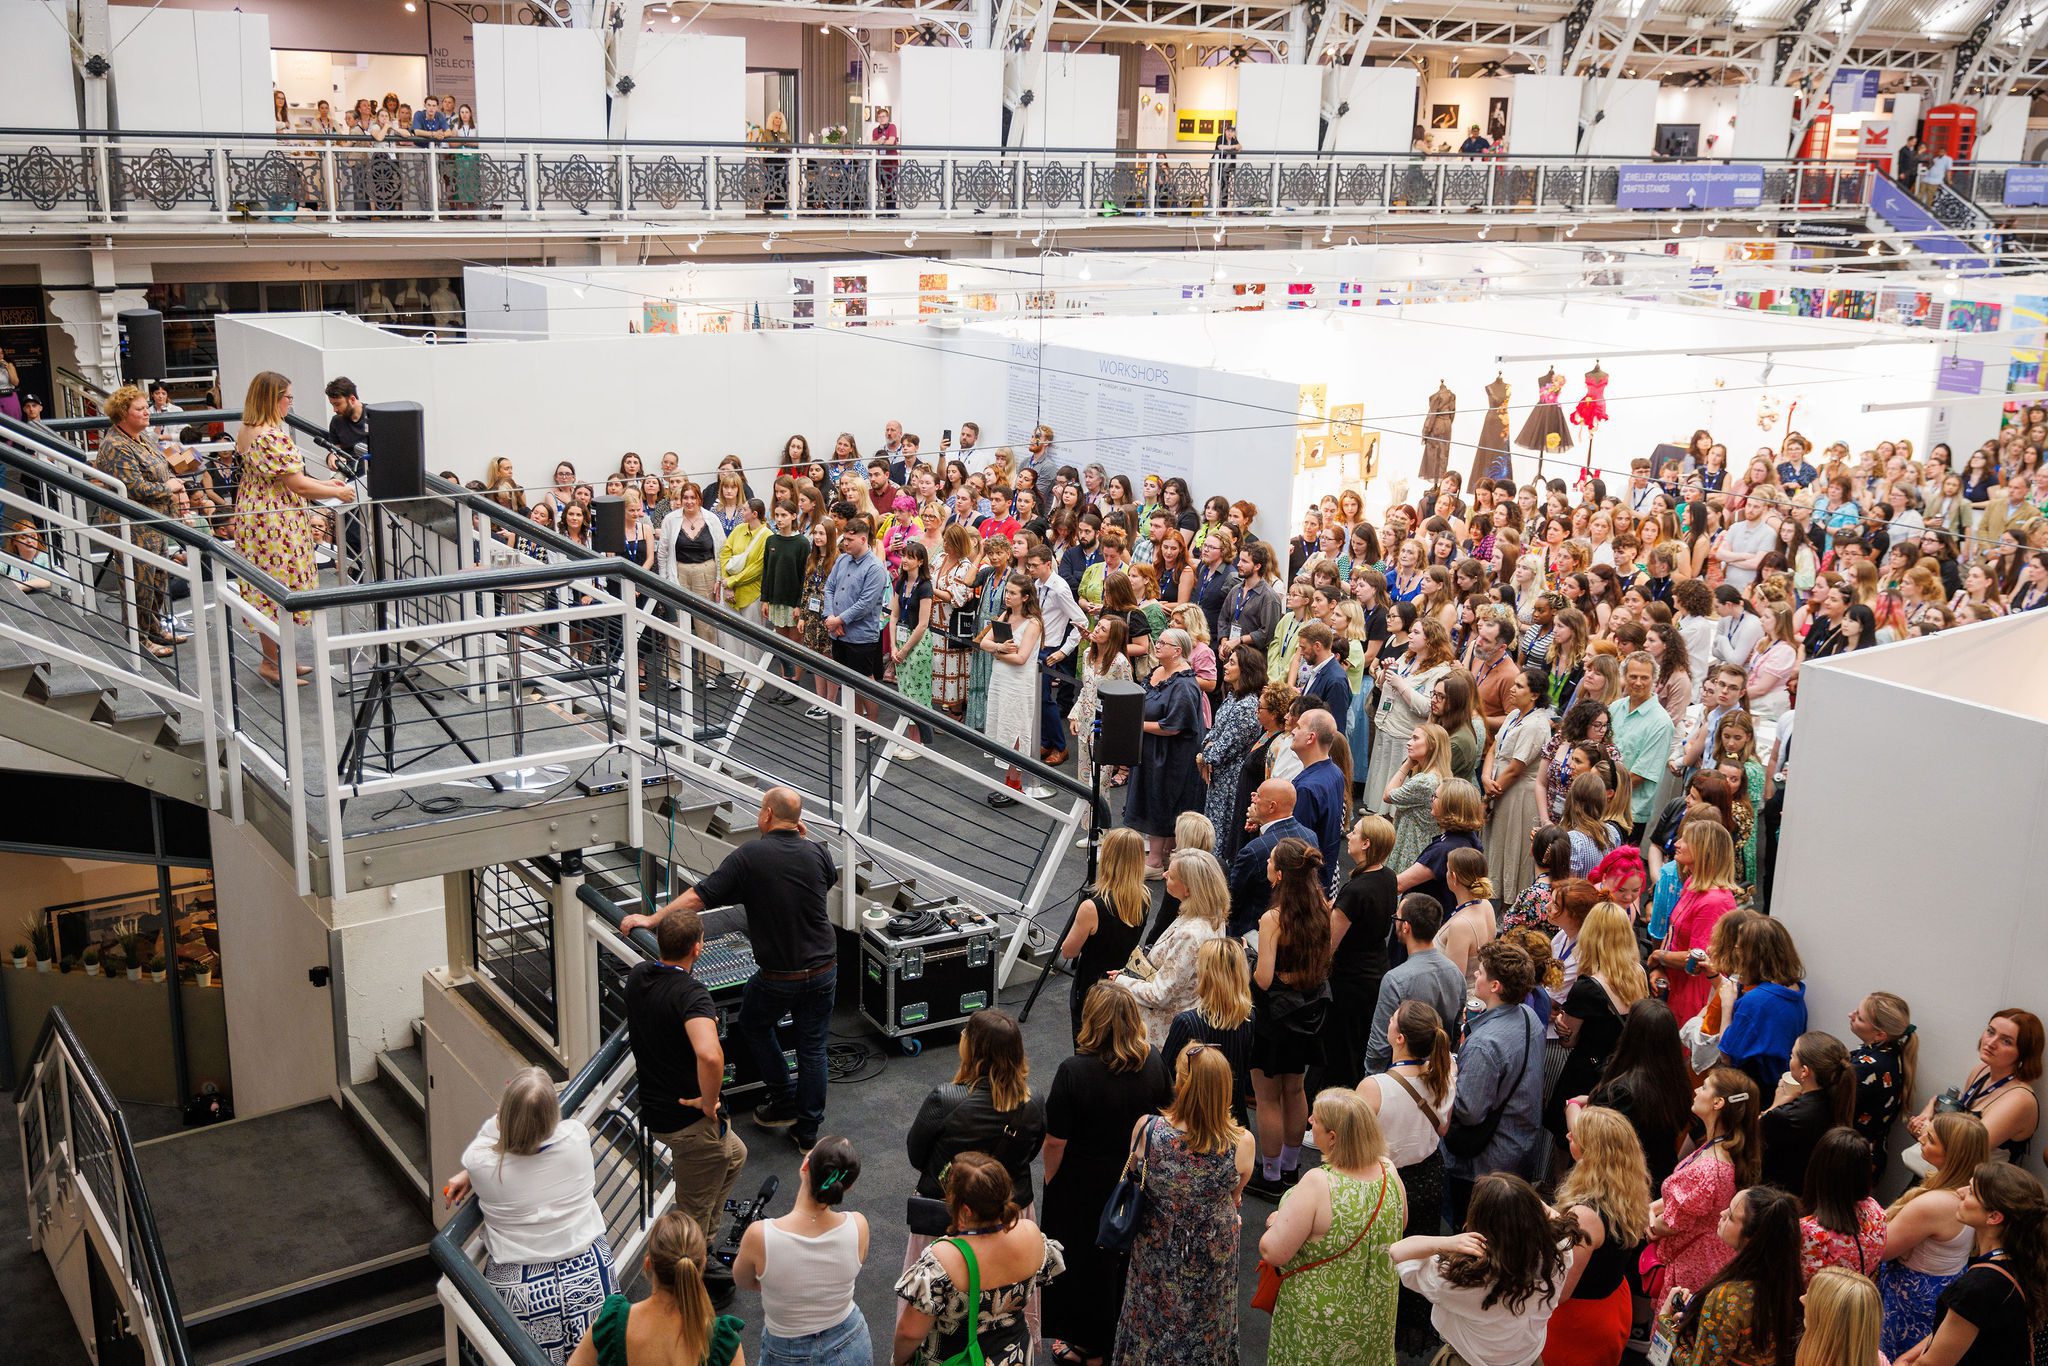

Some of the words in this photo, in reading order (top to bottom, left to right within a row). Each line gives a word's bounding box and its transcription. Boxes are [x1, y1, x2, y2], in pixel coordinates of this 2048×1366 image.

[434, 48, 449, 57] ND
[1010, 343, 1039, 361] TALKS
[1099, 359, 1169, 384] WORKSHOPS
